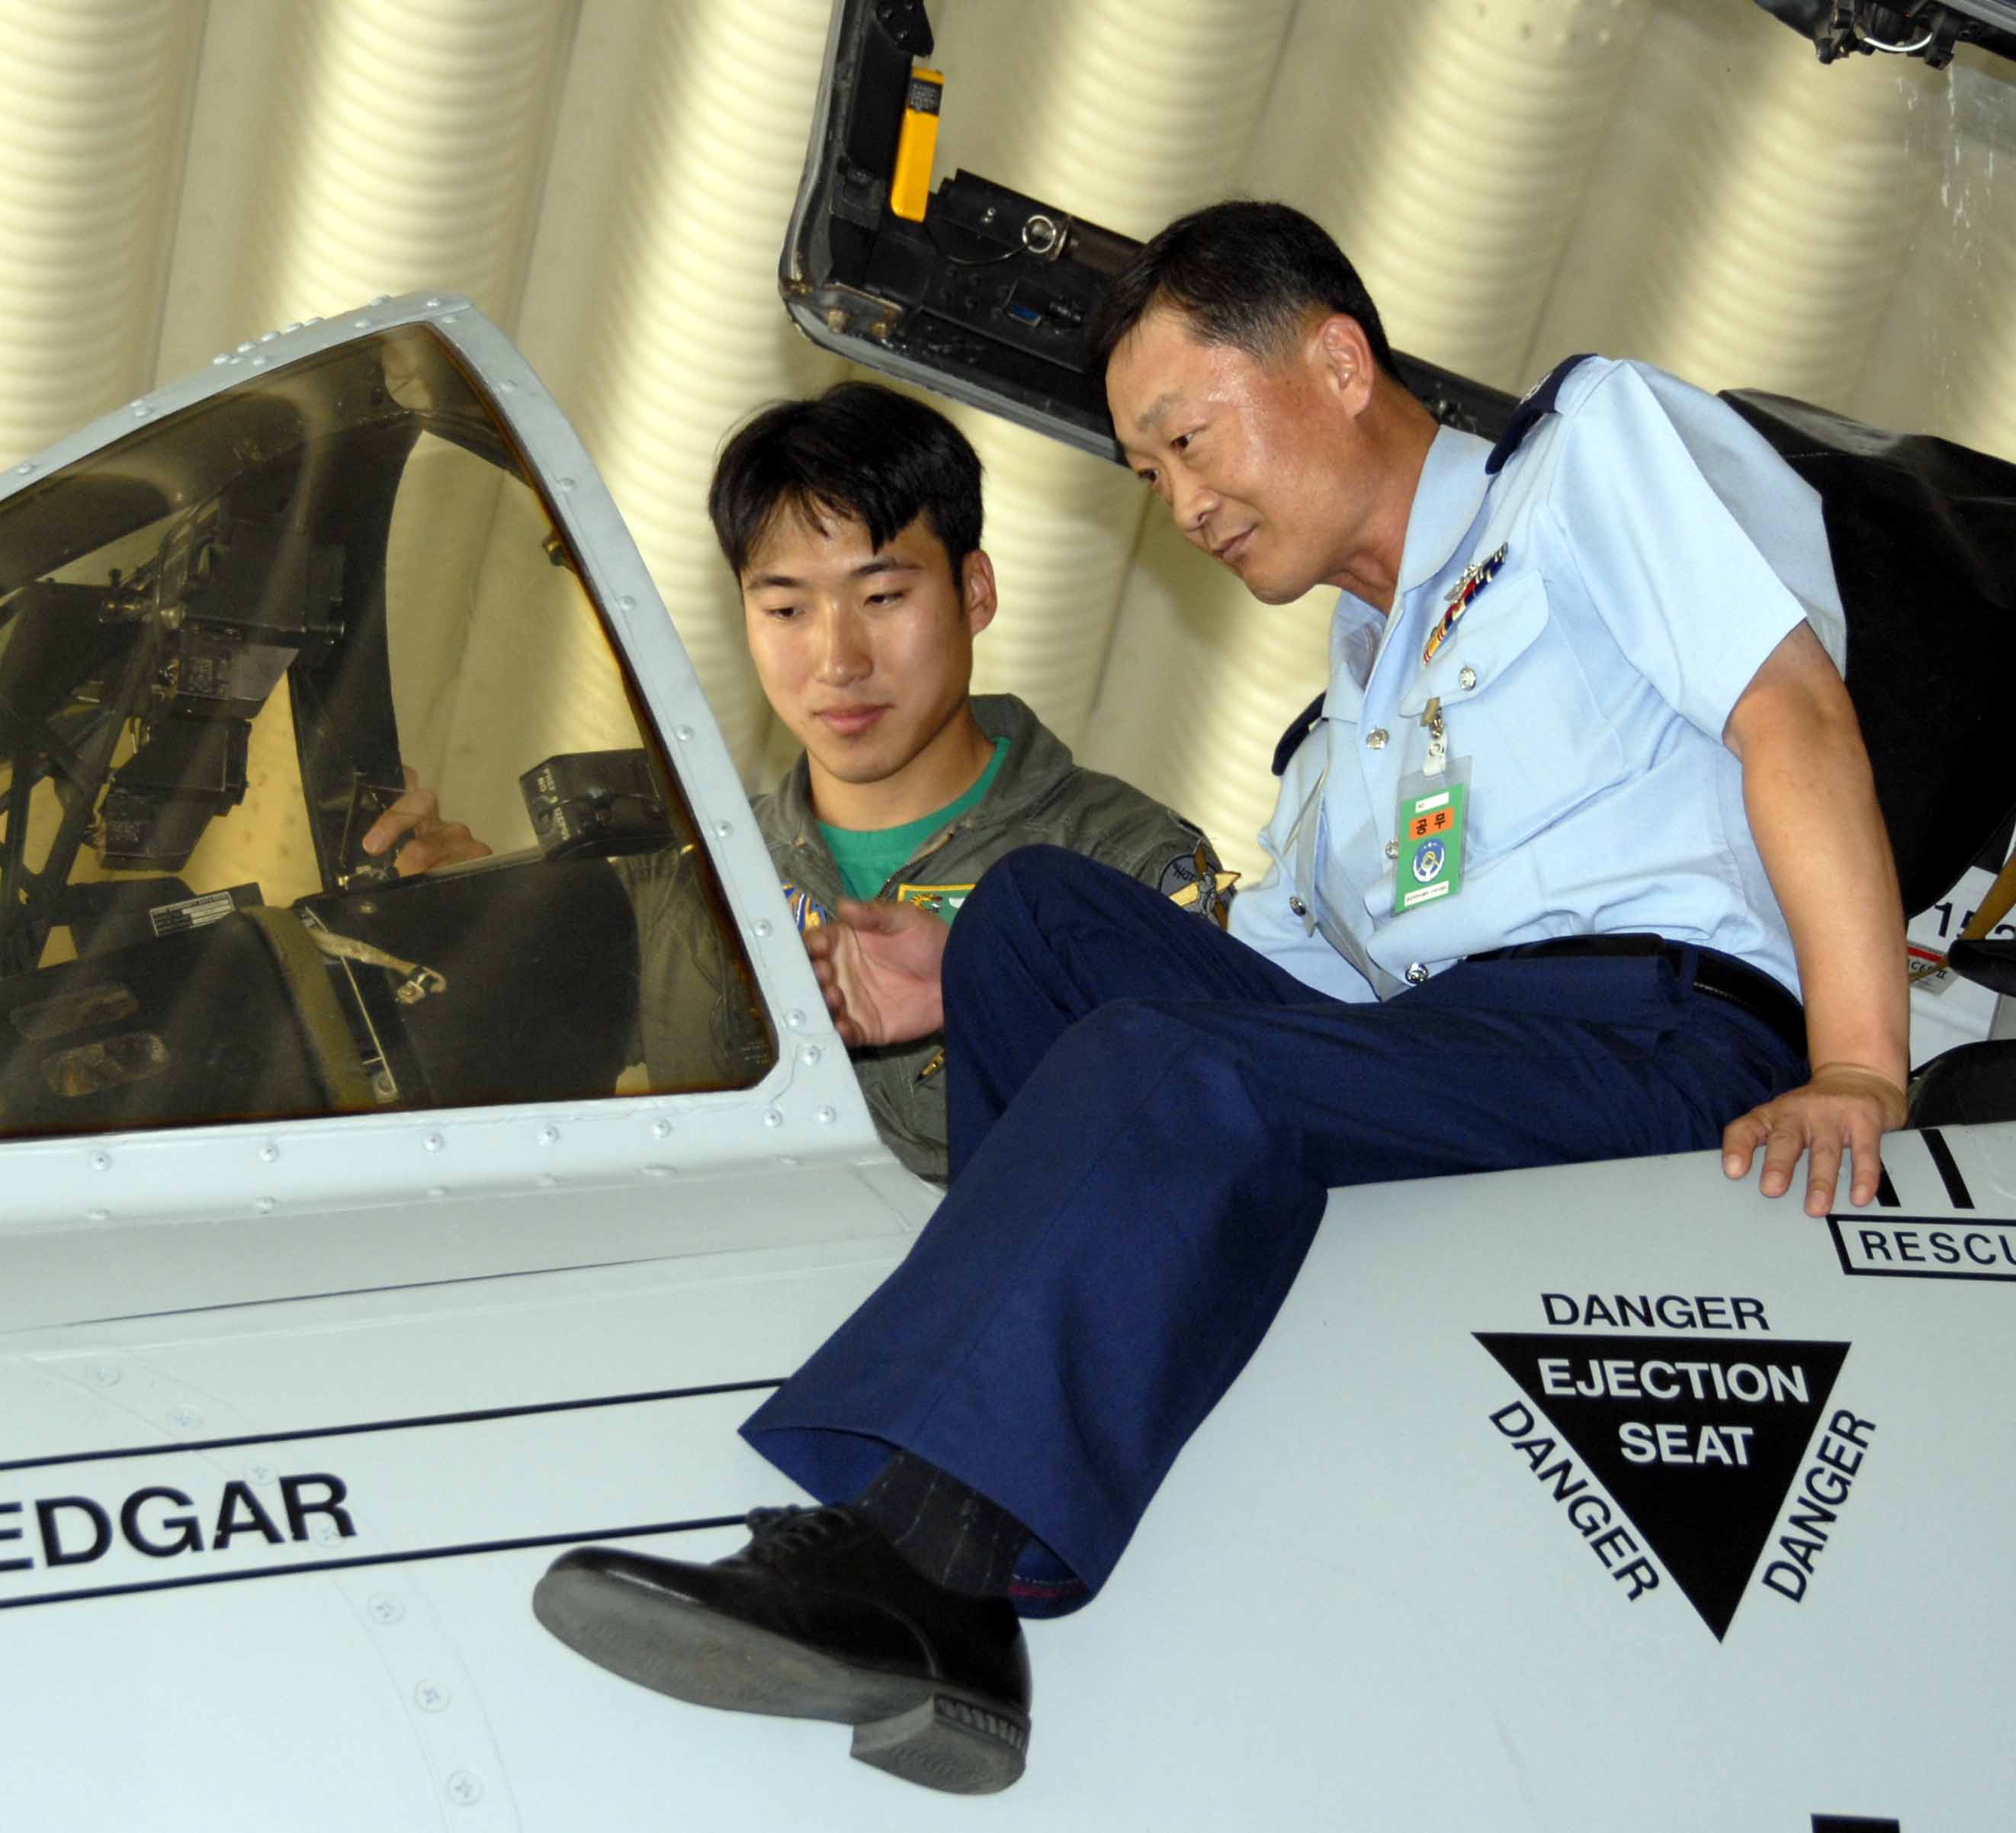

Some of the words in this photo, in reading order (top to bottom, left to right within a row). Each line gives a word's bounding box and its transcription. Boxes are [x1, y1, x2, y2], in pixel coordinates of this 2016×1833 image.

[1541, 1293, 1770, 1331] DANGER
[1537, 1358, 1809, 1403] EJECTION
[1618, 1421, 1754, 1465] SEAT
[1488, 1400, 1661, 1602] DANGER
[1761, 1409, 1876, 1604] DANGER
